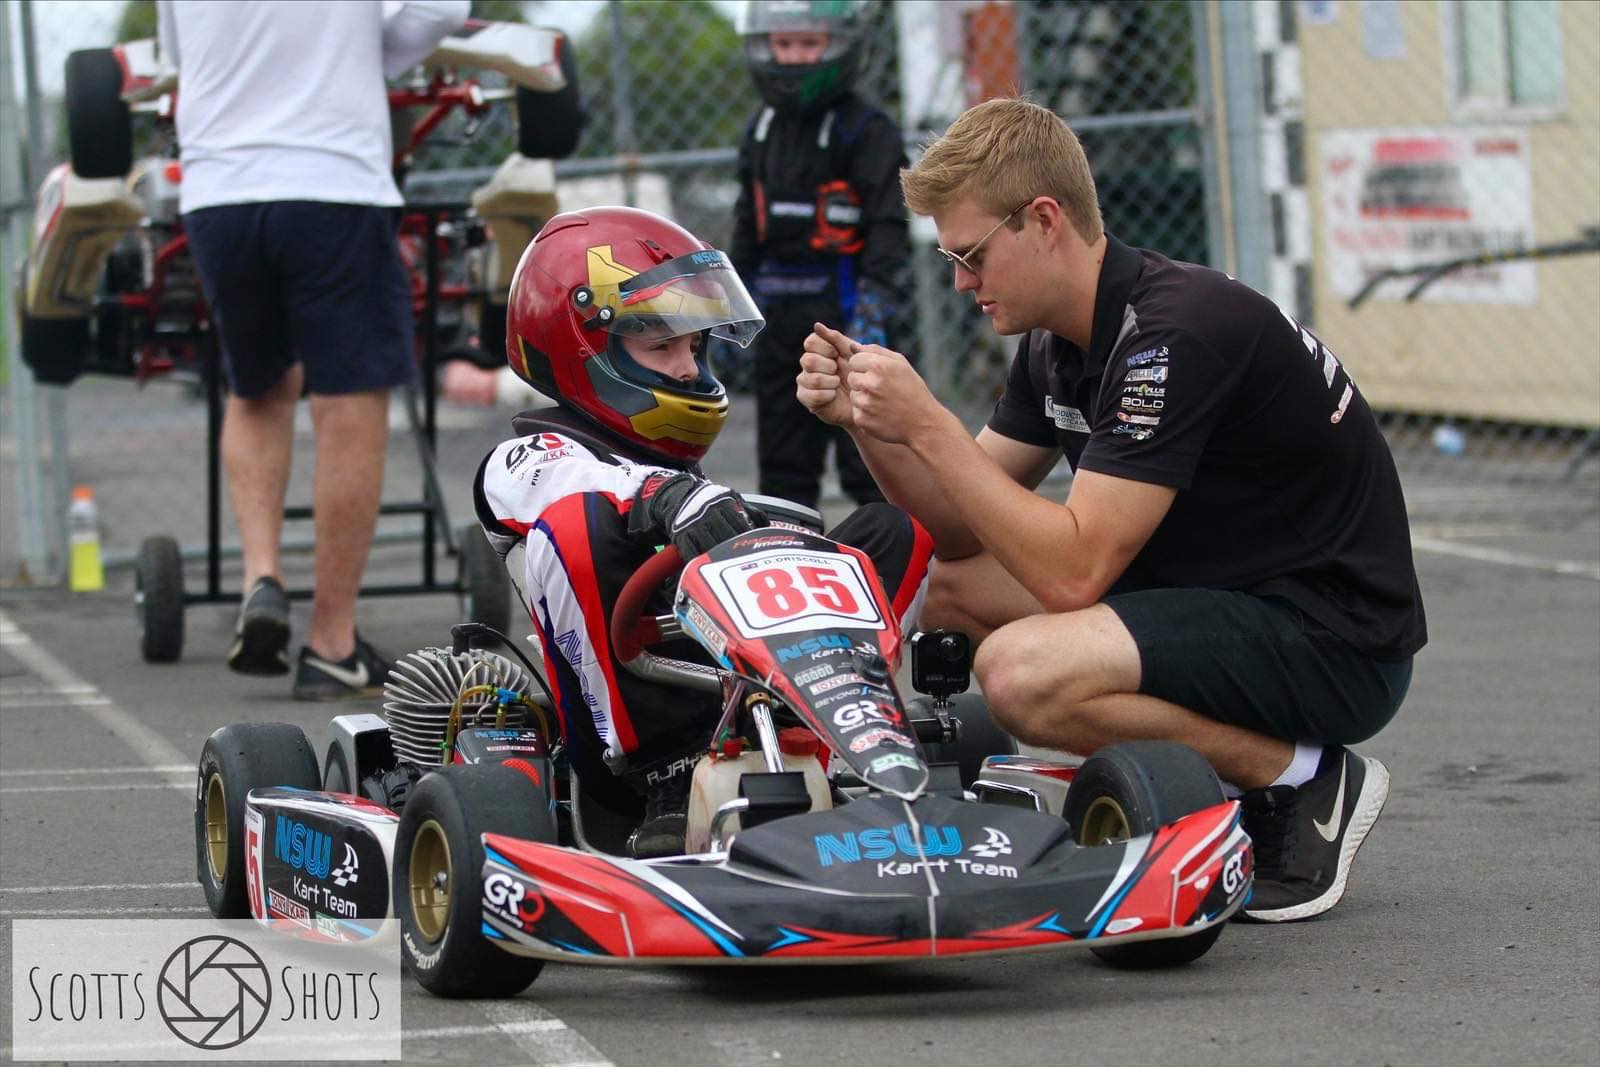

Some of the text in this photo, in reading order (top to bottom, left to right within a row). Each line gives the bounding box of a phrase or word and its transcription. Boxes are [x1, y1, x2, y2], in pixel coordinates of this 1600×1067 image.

[1121, 397, 1164, 409] BOLD
[732, 535, 797, 549] Racing
[752, 540, 805, 550] Image
[746, 566, 860, 619] 85
[776, 632, 853, 664] NSW
[811, 647, 844, 661] Kart
[833, 700, 902, 727] GRO
[274, 815, 332, 880] NSW
[814, 823, 963, 867] NSW
[244, 826, 264, 920] 5
[877, 858, 1018, 879] Kart Team
[292, 876, 358, 919] Kart Team
[484, 873, 545, 923] GRO
